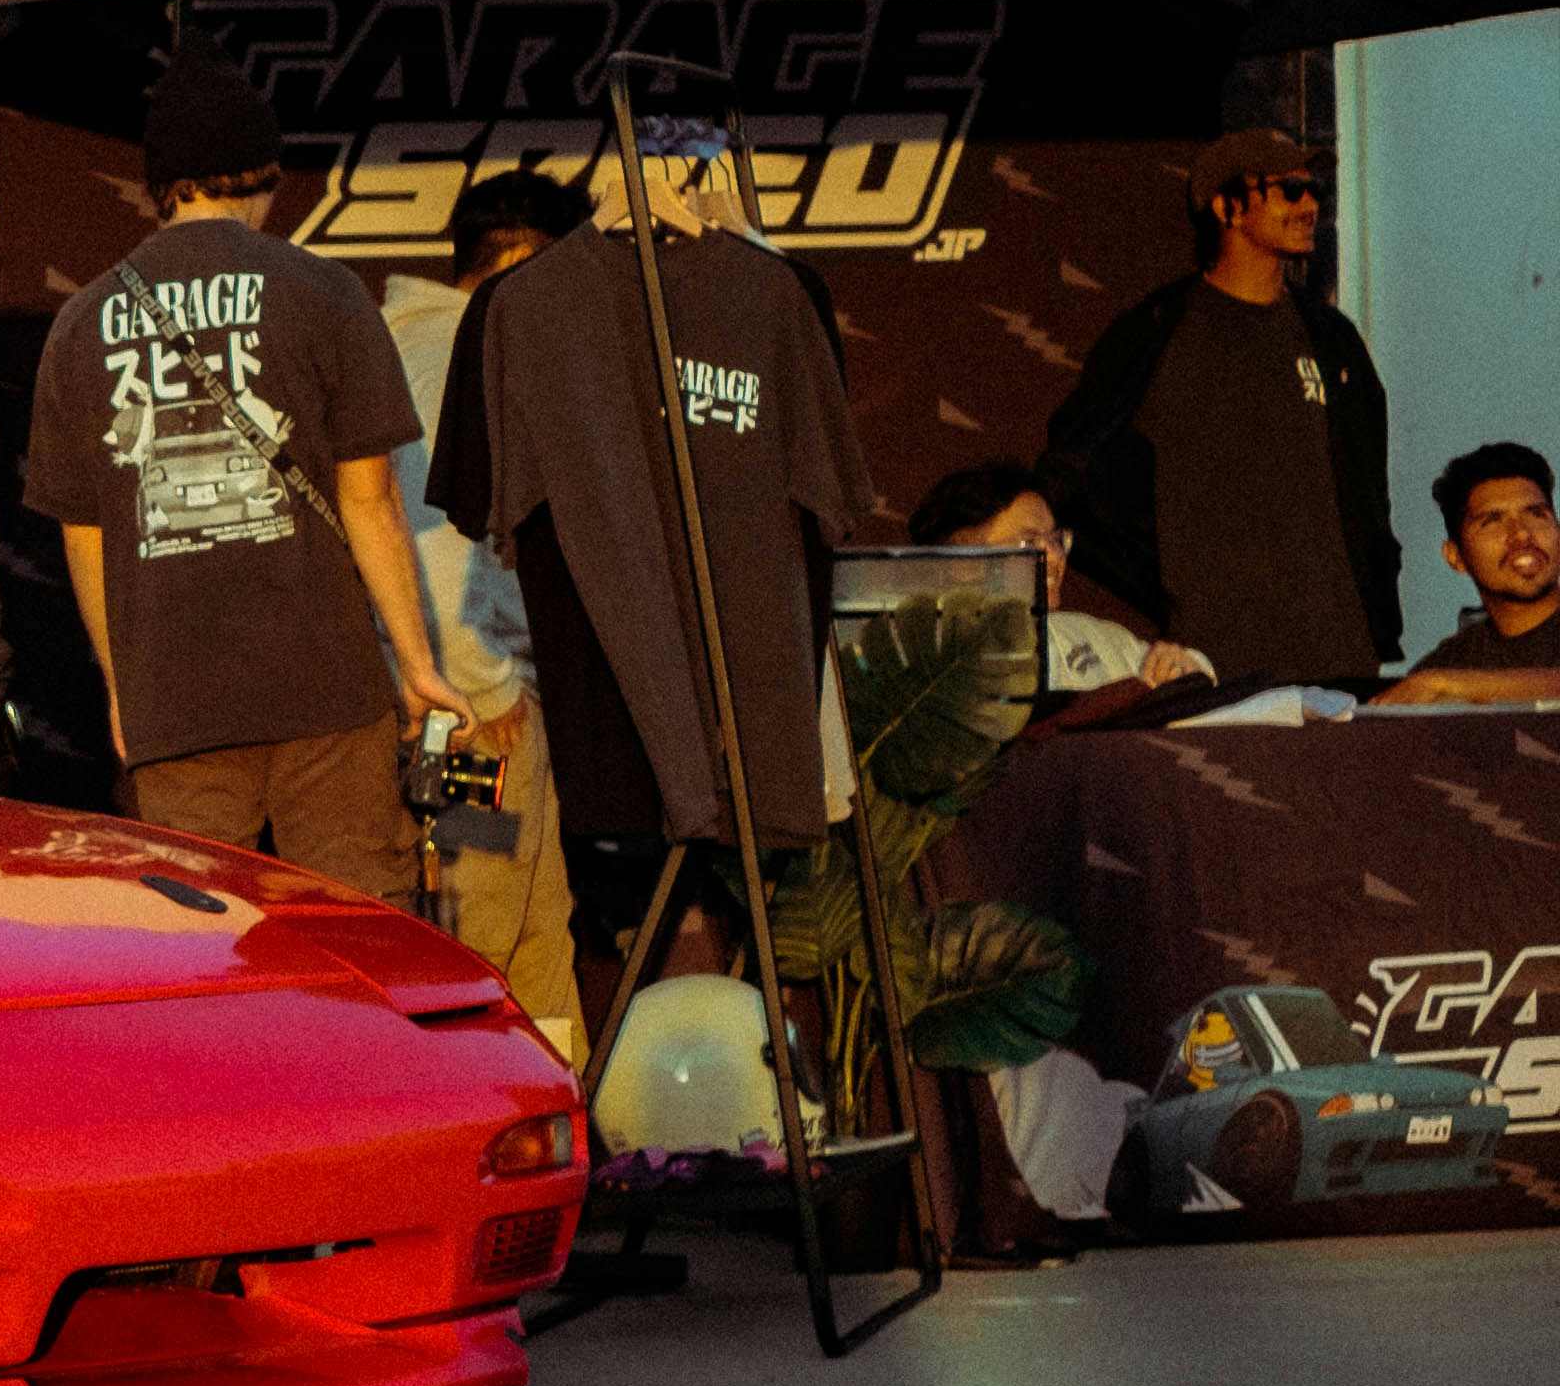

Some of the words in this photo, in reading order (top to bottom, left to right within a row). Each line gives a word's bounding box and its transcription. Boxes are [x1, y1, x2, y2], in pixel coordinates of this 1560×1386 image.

[102, 272, 265, 346] GARAGE
[674, 356, 760, 406] ARAGE
[661, 393, 758, 434] ピード
